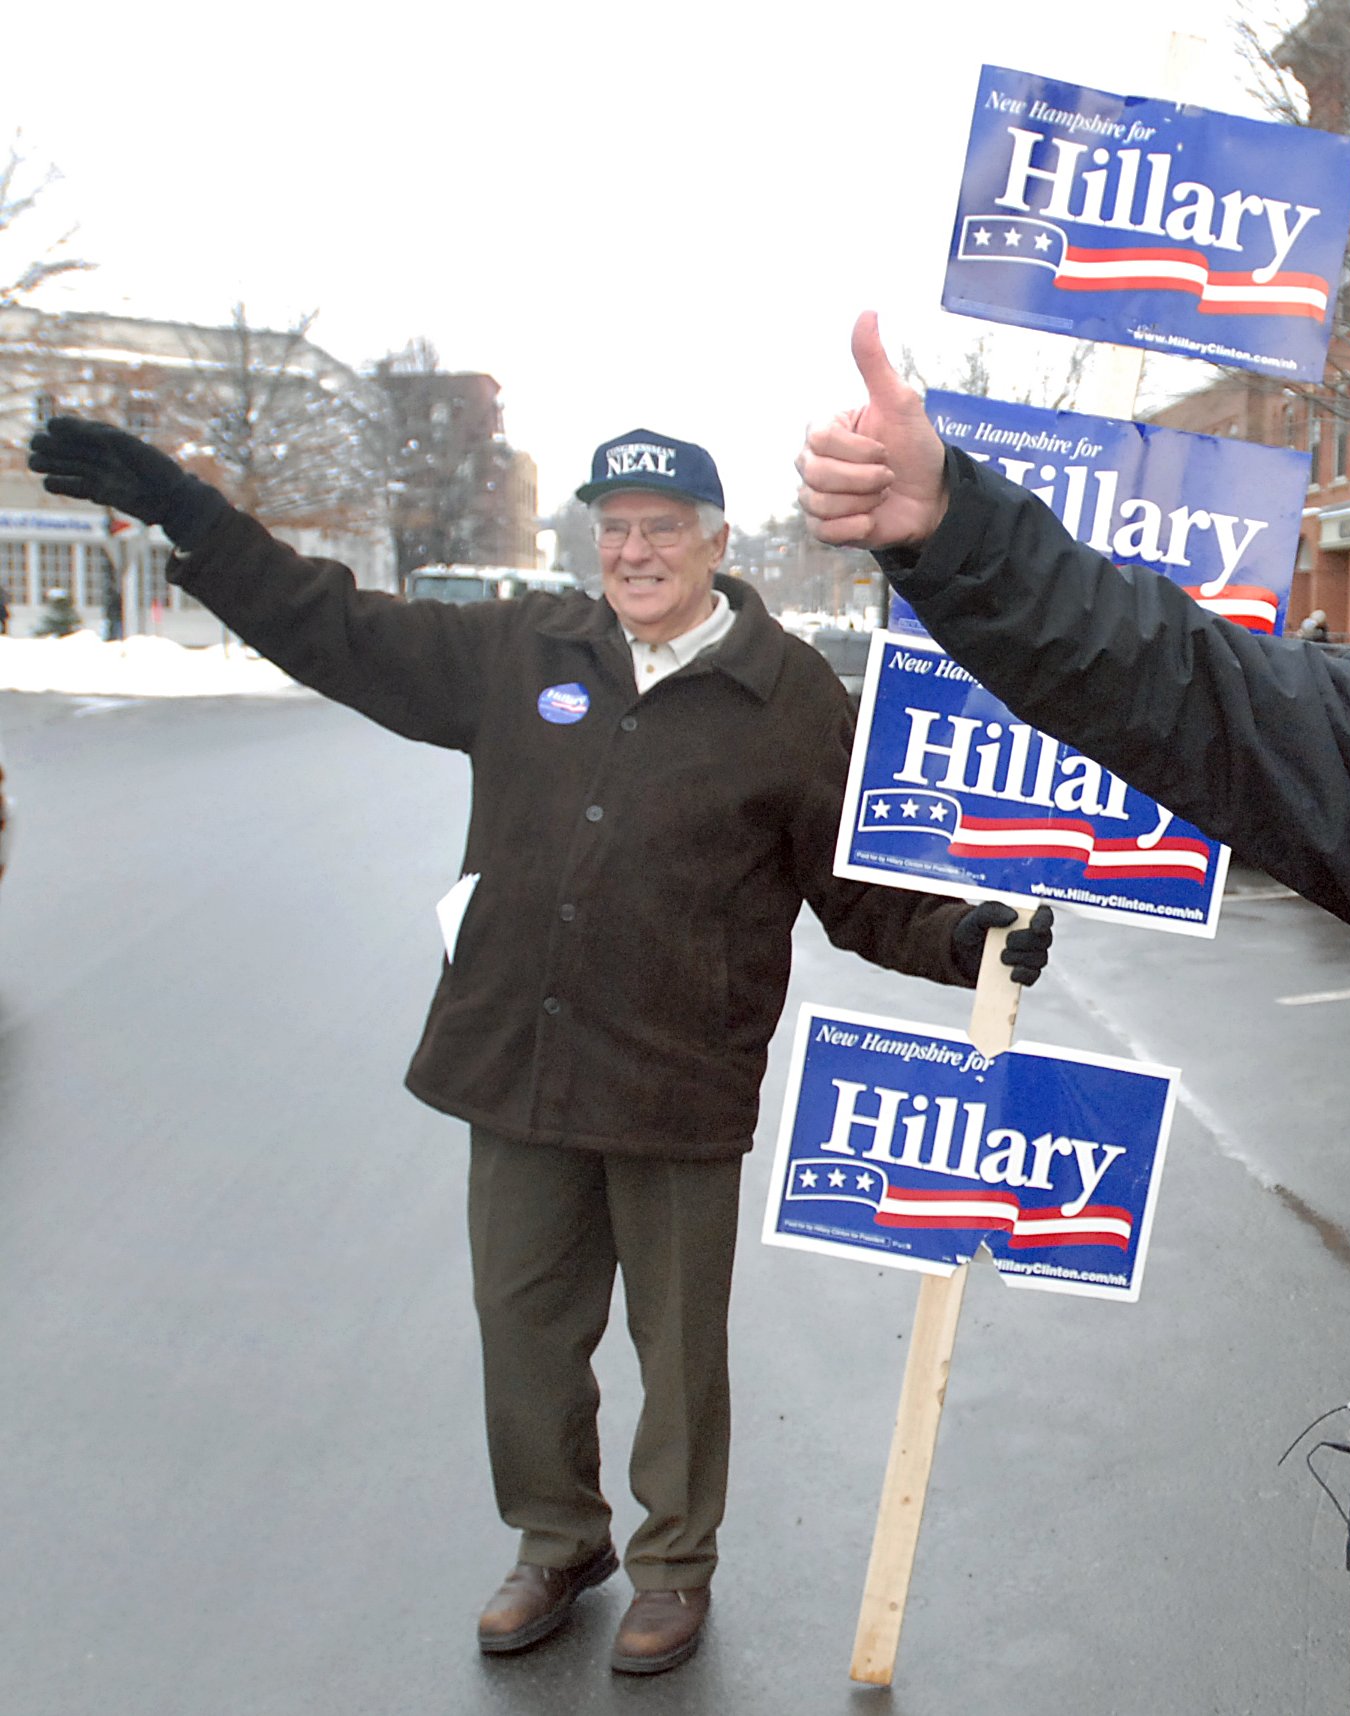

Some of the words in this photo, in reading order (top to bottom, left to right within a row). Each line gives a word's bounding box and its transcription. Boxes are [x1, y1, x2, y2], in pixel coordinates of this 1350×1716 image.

[985, 90, 1023, 114] New
[1029, 99, 1122, 139] Hampshire
[1122, 117, 1156, 144] for
[994, 126, 1321, 283] Hillary
[934, 415, 972, 437] New
[974, 421, 1072, 454] Hampshire
[1069, 437, 1103, 460] for
[606, 451, 677, 479] NEAL
[888, 651, 933, 675] New
[1031, 883, 1203, 920] www.HillaryClinton.com/nh
[815, 1024, 857, 1048] New
[861, 1032, 962, 1068] Hampshire
[958, 1050, 994, 1072] for
[820, 1078, 1126, 1217] Hillary
